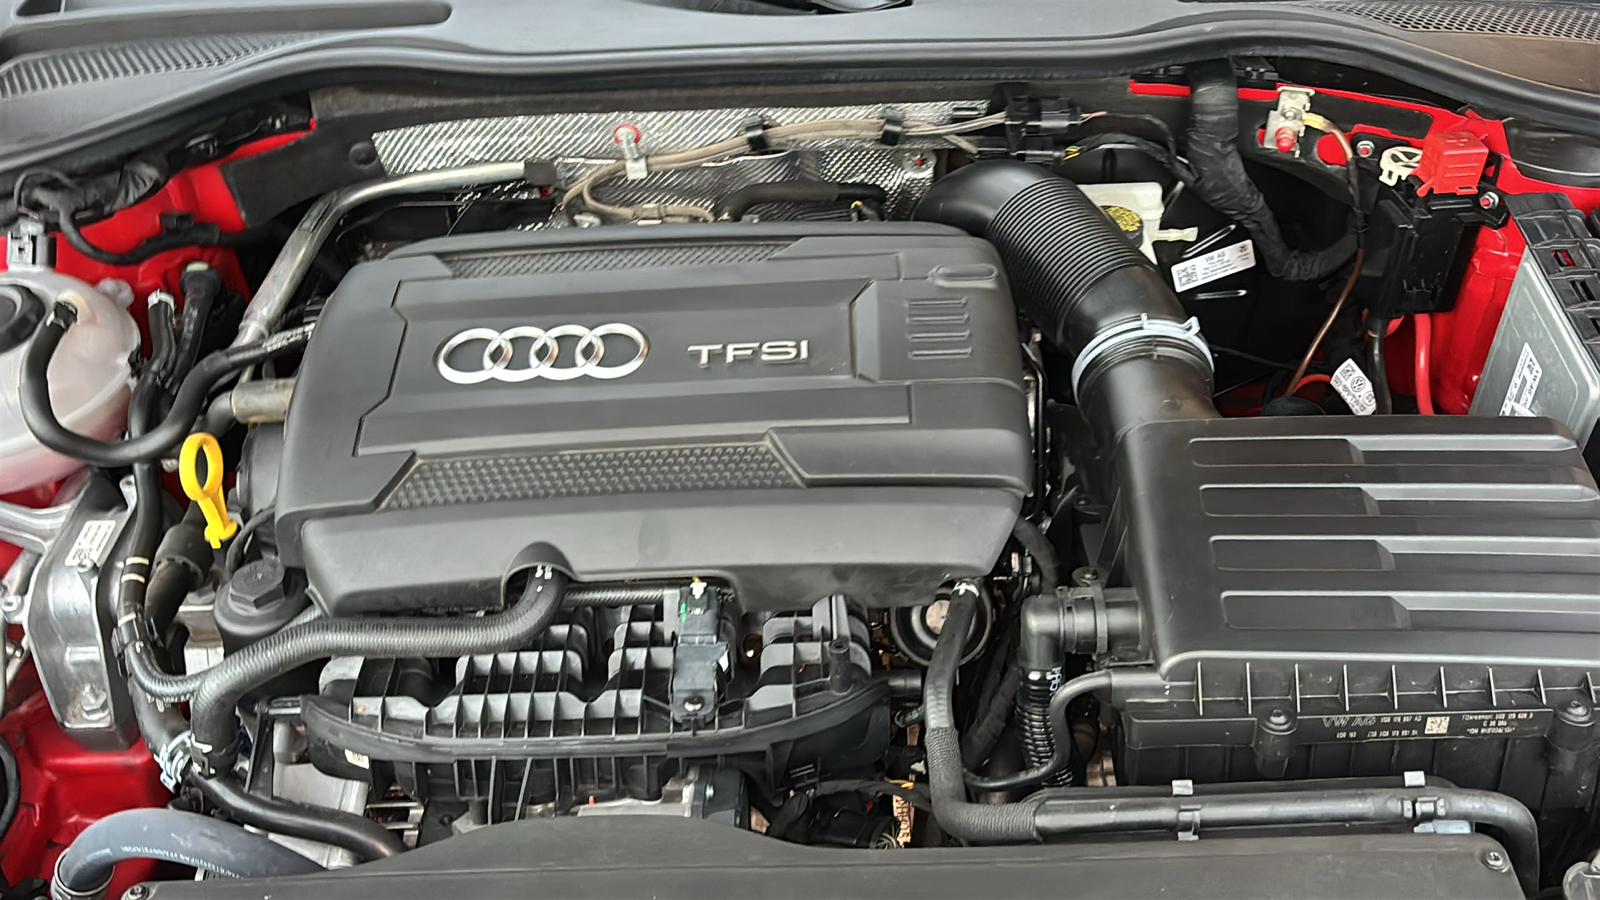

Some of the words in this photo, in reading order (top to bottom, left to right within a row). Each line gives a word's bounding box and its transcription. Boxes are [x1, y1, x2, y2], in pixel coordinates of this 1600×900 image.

[687, 340, 809, 367] TFSI
[1322, 716, 1350, 727] VW
[1351, 716, 1377, 727] AG
